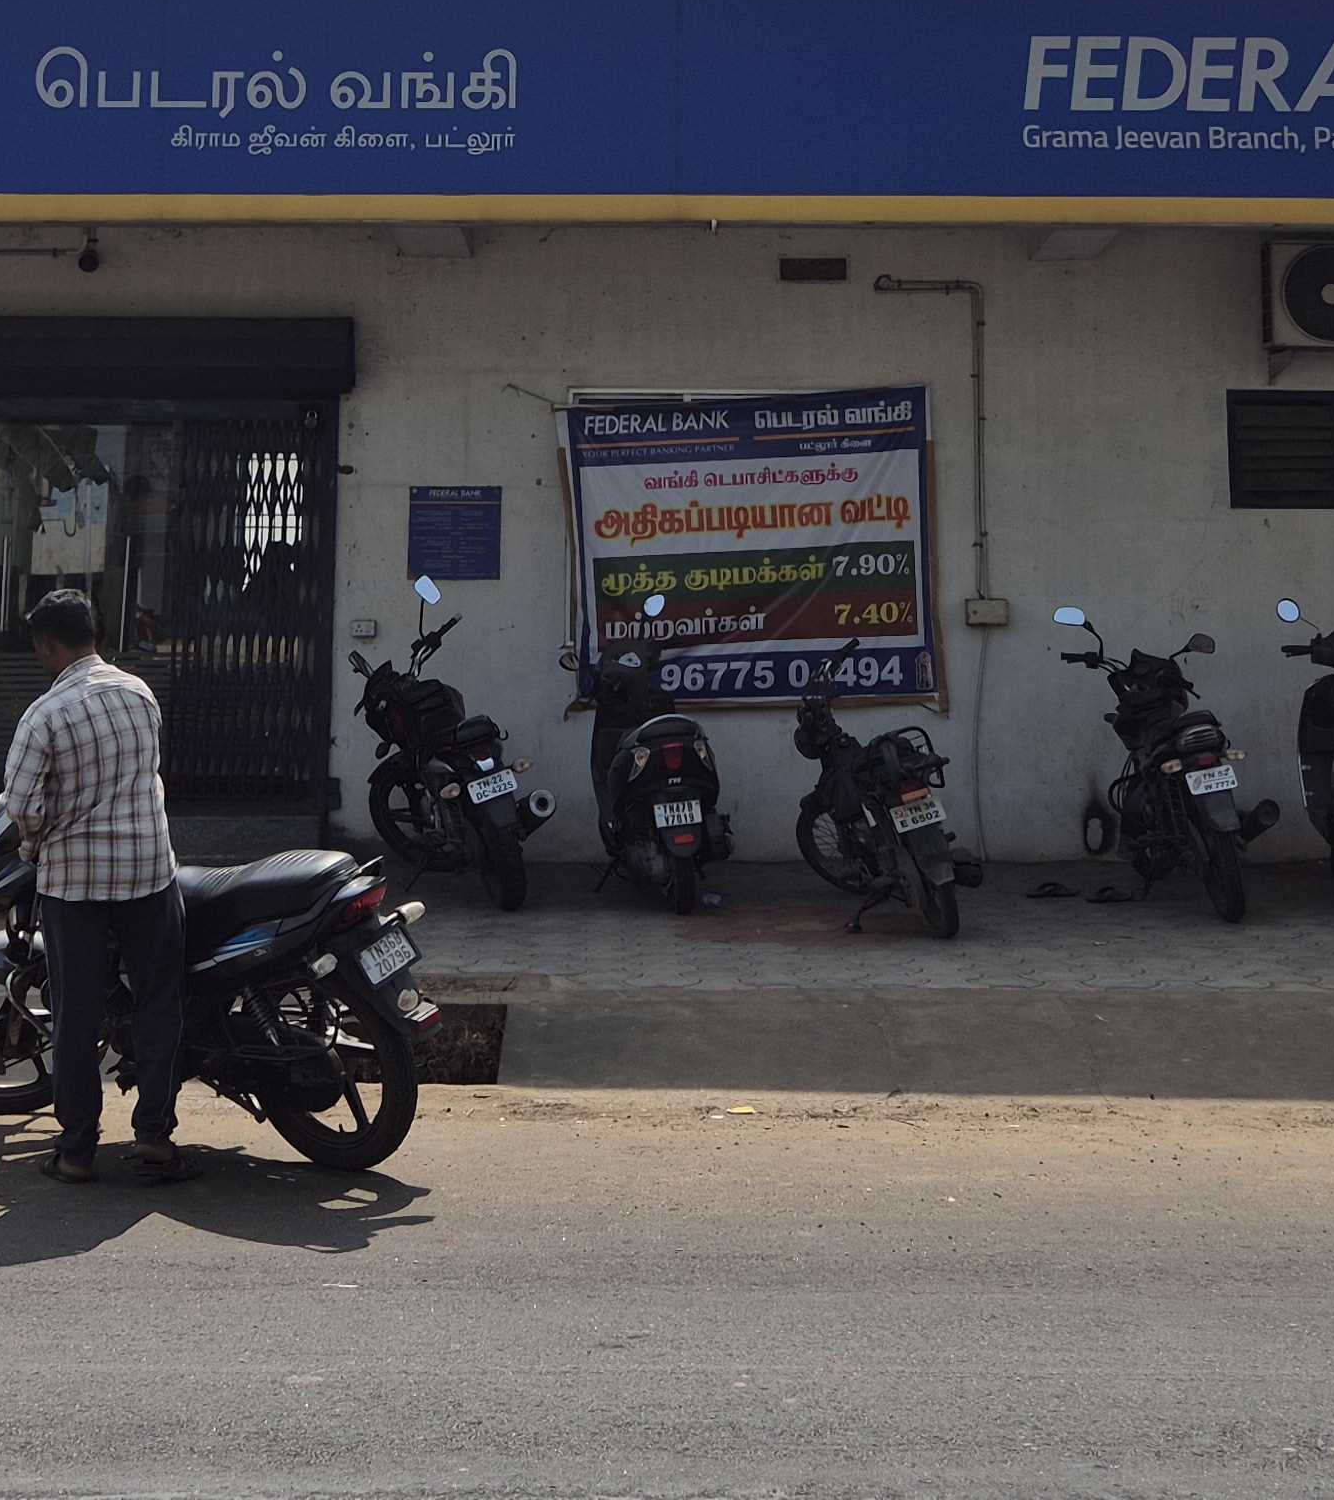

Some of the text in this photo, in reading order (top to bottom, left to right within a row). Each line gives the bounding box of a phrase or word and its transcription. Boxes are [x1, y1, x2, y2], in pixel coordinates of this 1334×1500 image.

[36, 46, 516, 118] பெடரல் வங்கி
[170, 125, 516, 155] கிராம ஜீவன் கிளை, பட்லூர்
[1023, 125, 1108, 149] Grama
[1115, 125, 1200, 149] Jeevan
[1209, 125, 1307, 152] Branch,
[584, 410, 730, 436] FEDERAL BANK
[754, 400, 912, 430] பெடரல் வங்கி
[644, 462, 859, 490] வங்கி டெபாசிட்களுக்கு
[593, 492, 911, 547] அதிகப்படியான வட்டி
[601, 553, 910, 596] மூத்த குடிமக்கள் 7.90%
[605, 602, 913, 641] மற்றவர்கள் 7.40%
[660, 655, 903, 691] 96775 0494
[367, 932, 402, 961] TN36B
